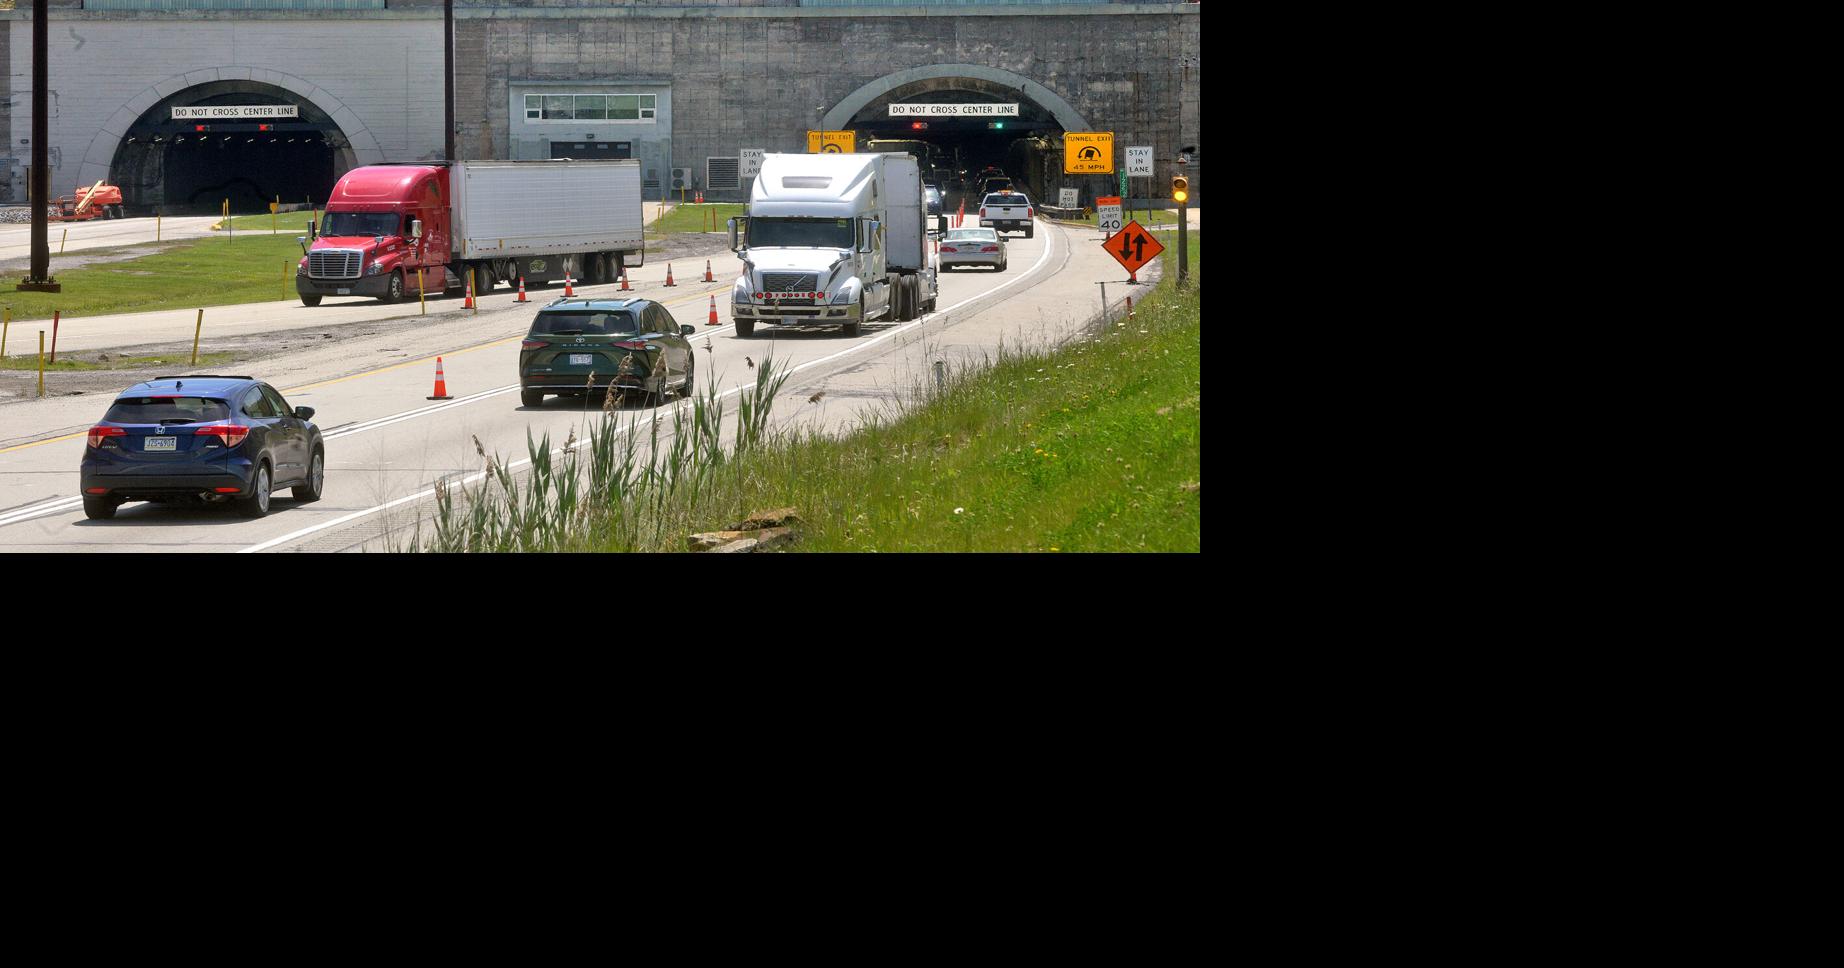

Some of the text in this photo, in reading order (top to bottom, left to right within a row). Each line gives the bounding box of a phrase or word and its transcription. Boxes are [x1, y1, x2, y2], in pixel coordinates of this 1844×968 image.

[175, 107, 294, 117] DO NOT CROSS CENTER LINE
[892, 106, 1014, 114] DO NOT CROSS CENTER LINE
[1101, 220, 1121, 229] 40
